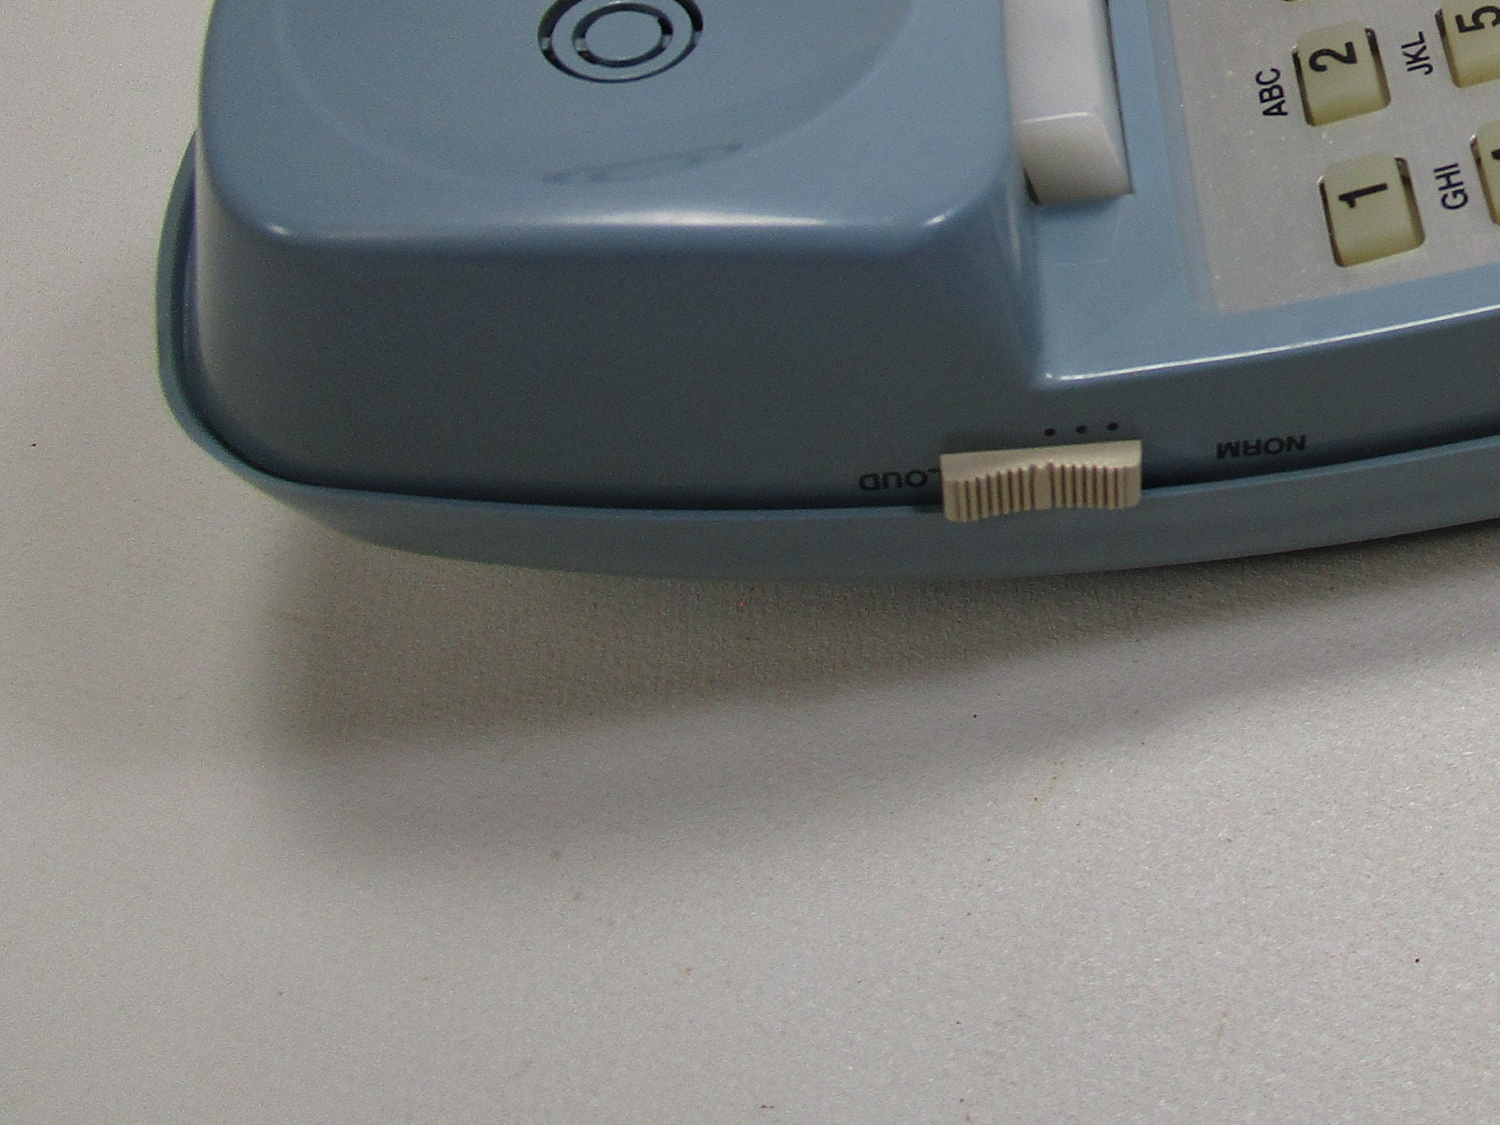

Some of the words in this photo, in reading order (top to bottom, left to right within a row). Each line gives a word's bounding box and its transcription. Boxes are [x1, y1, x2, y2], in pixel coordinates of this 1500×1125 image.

[1309, 42, 1357, 72] 2
[1401, 31, 1433, 76] JKL
[1255, 67, 1288, 117] ABC
[1339, 182, 1388, 208] 1
[1434, 163, 1468, 210] GHI
[1216, 434, 1307, 459] NORM
